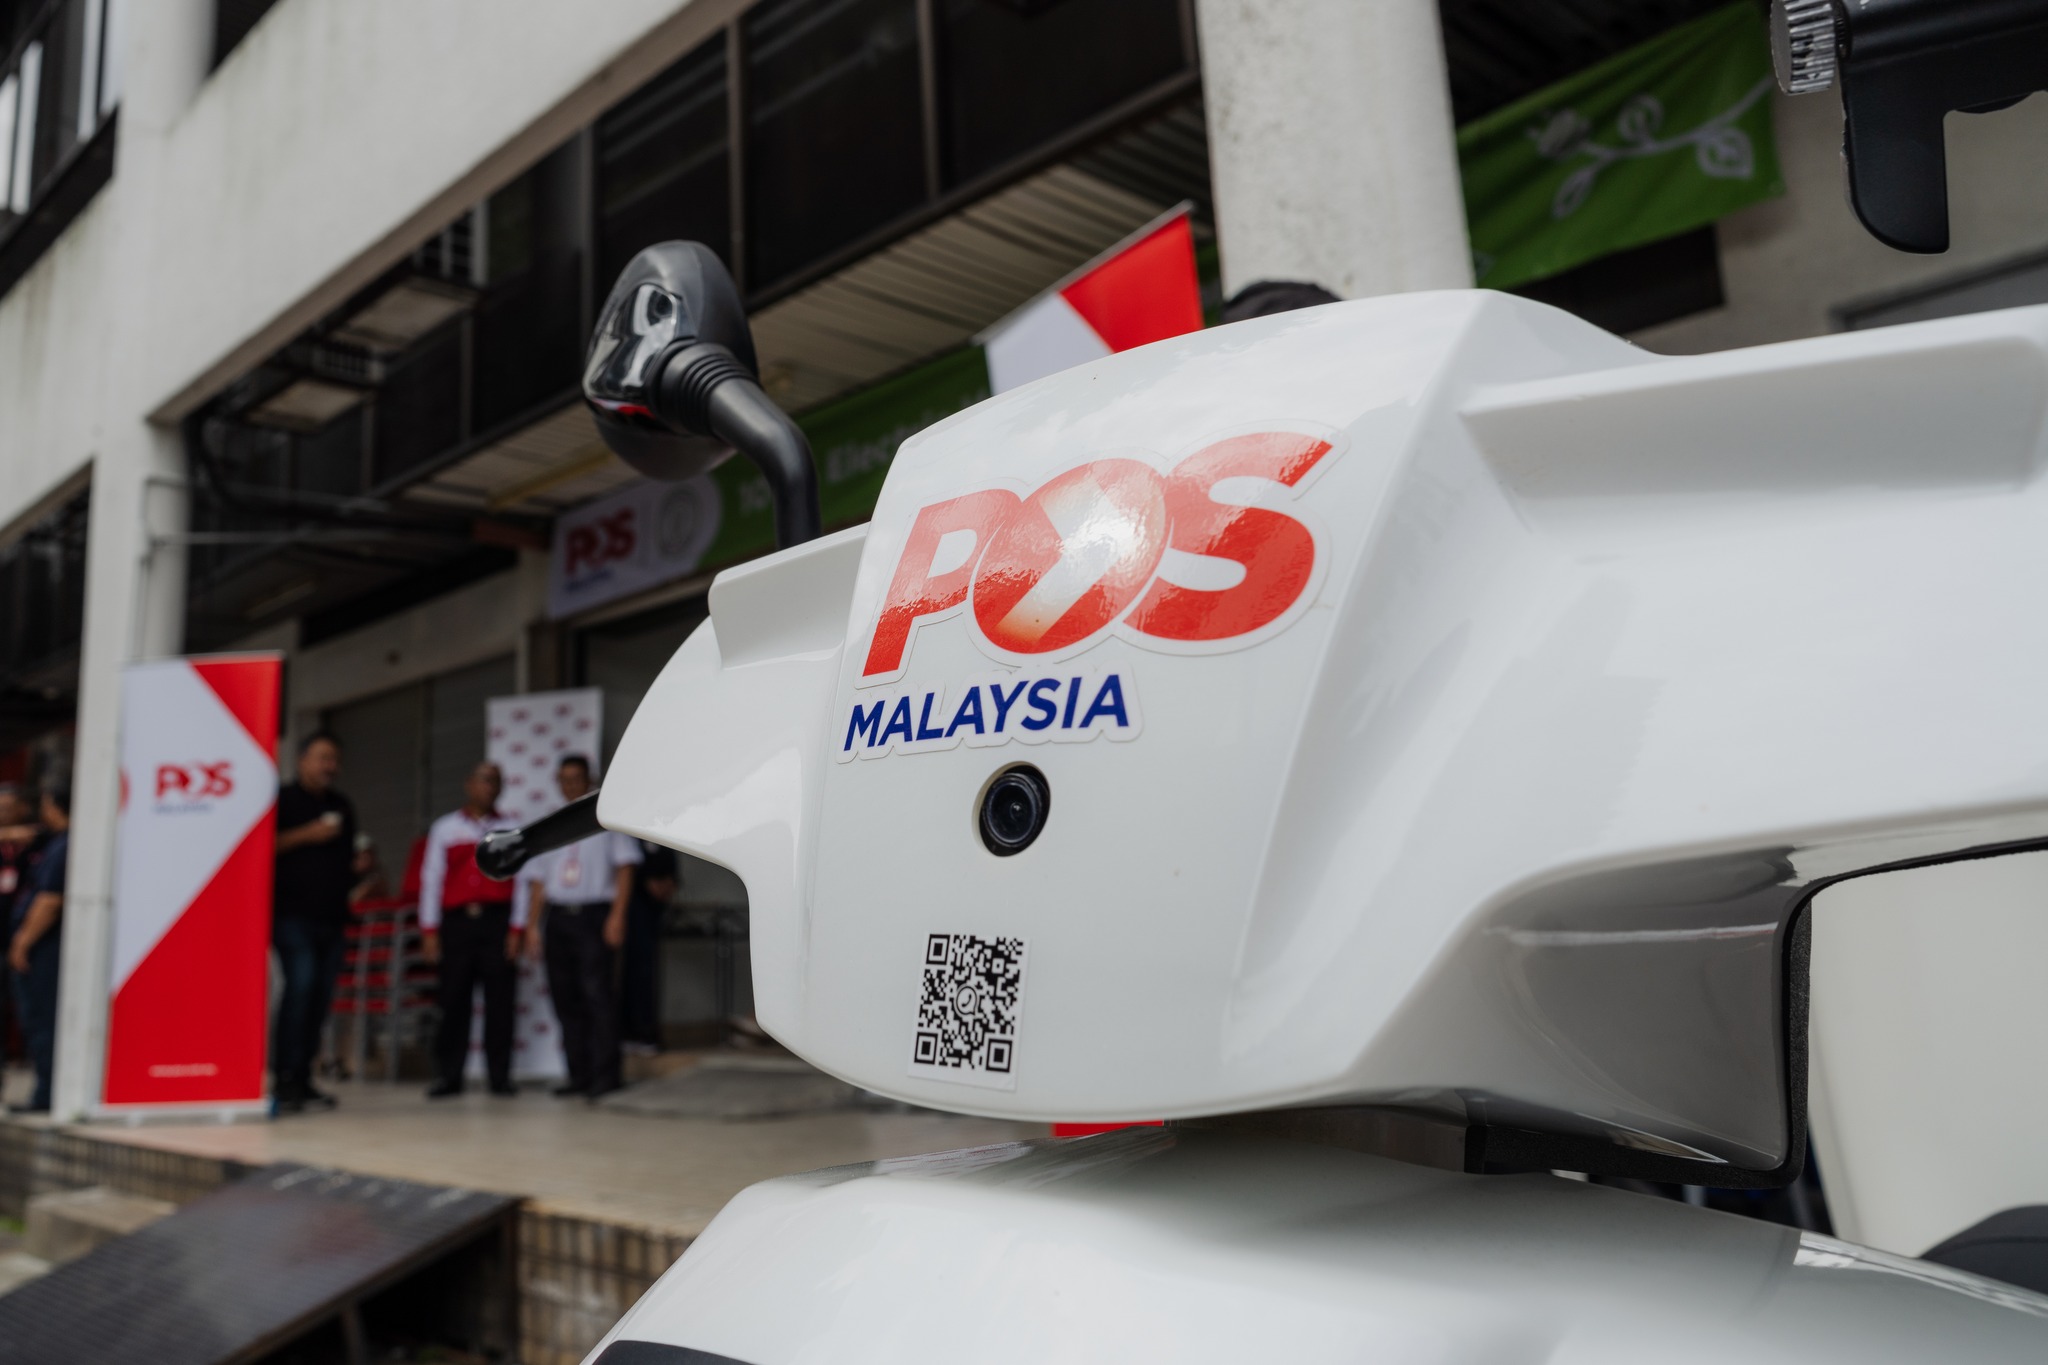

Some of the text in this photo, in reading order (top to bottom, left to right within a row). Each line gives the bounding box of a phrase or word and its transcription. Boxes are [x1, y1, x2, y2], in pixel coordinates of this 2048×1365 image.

[564, 505, 636, 577] POS
[862, 431, 1334, 677] POS
[843, 674, 1130, 752] MALAYSIA
[155, 759, 234, 802] POS
